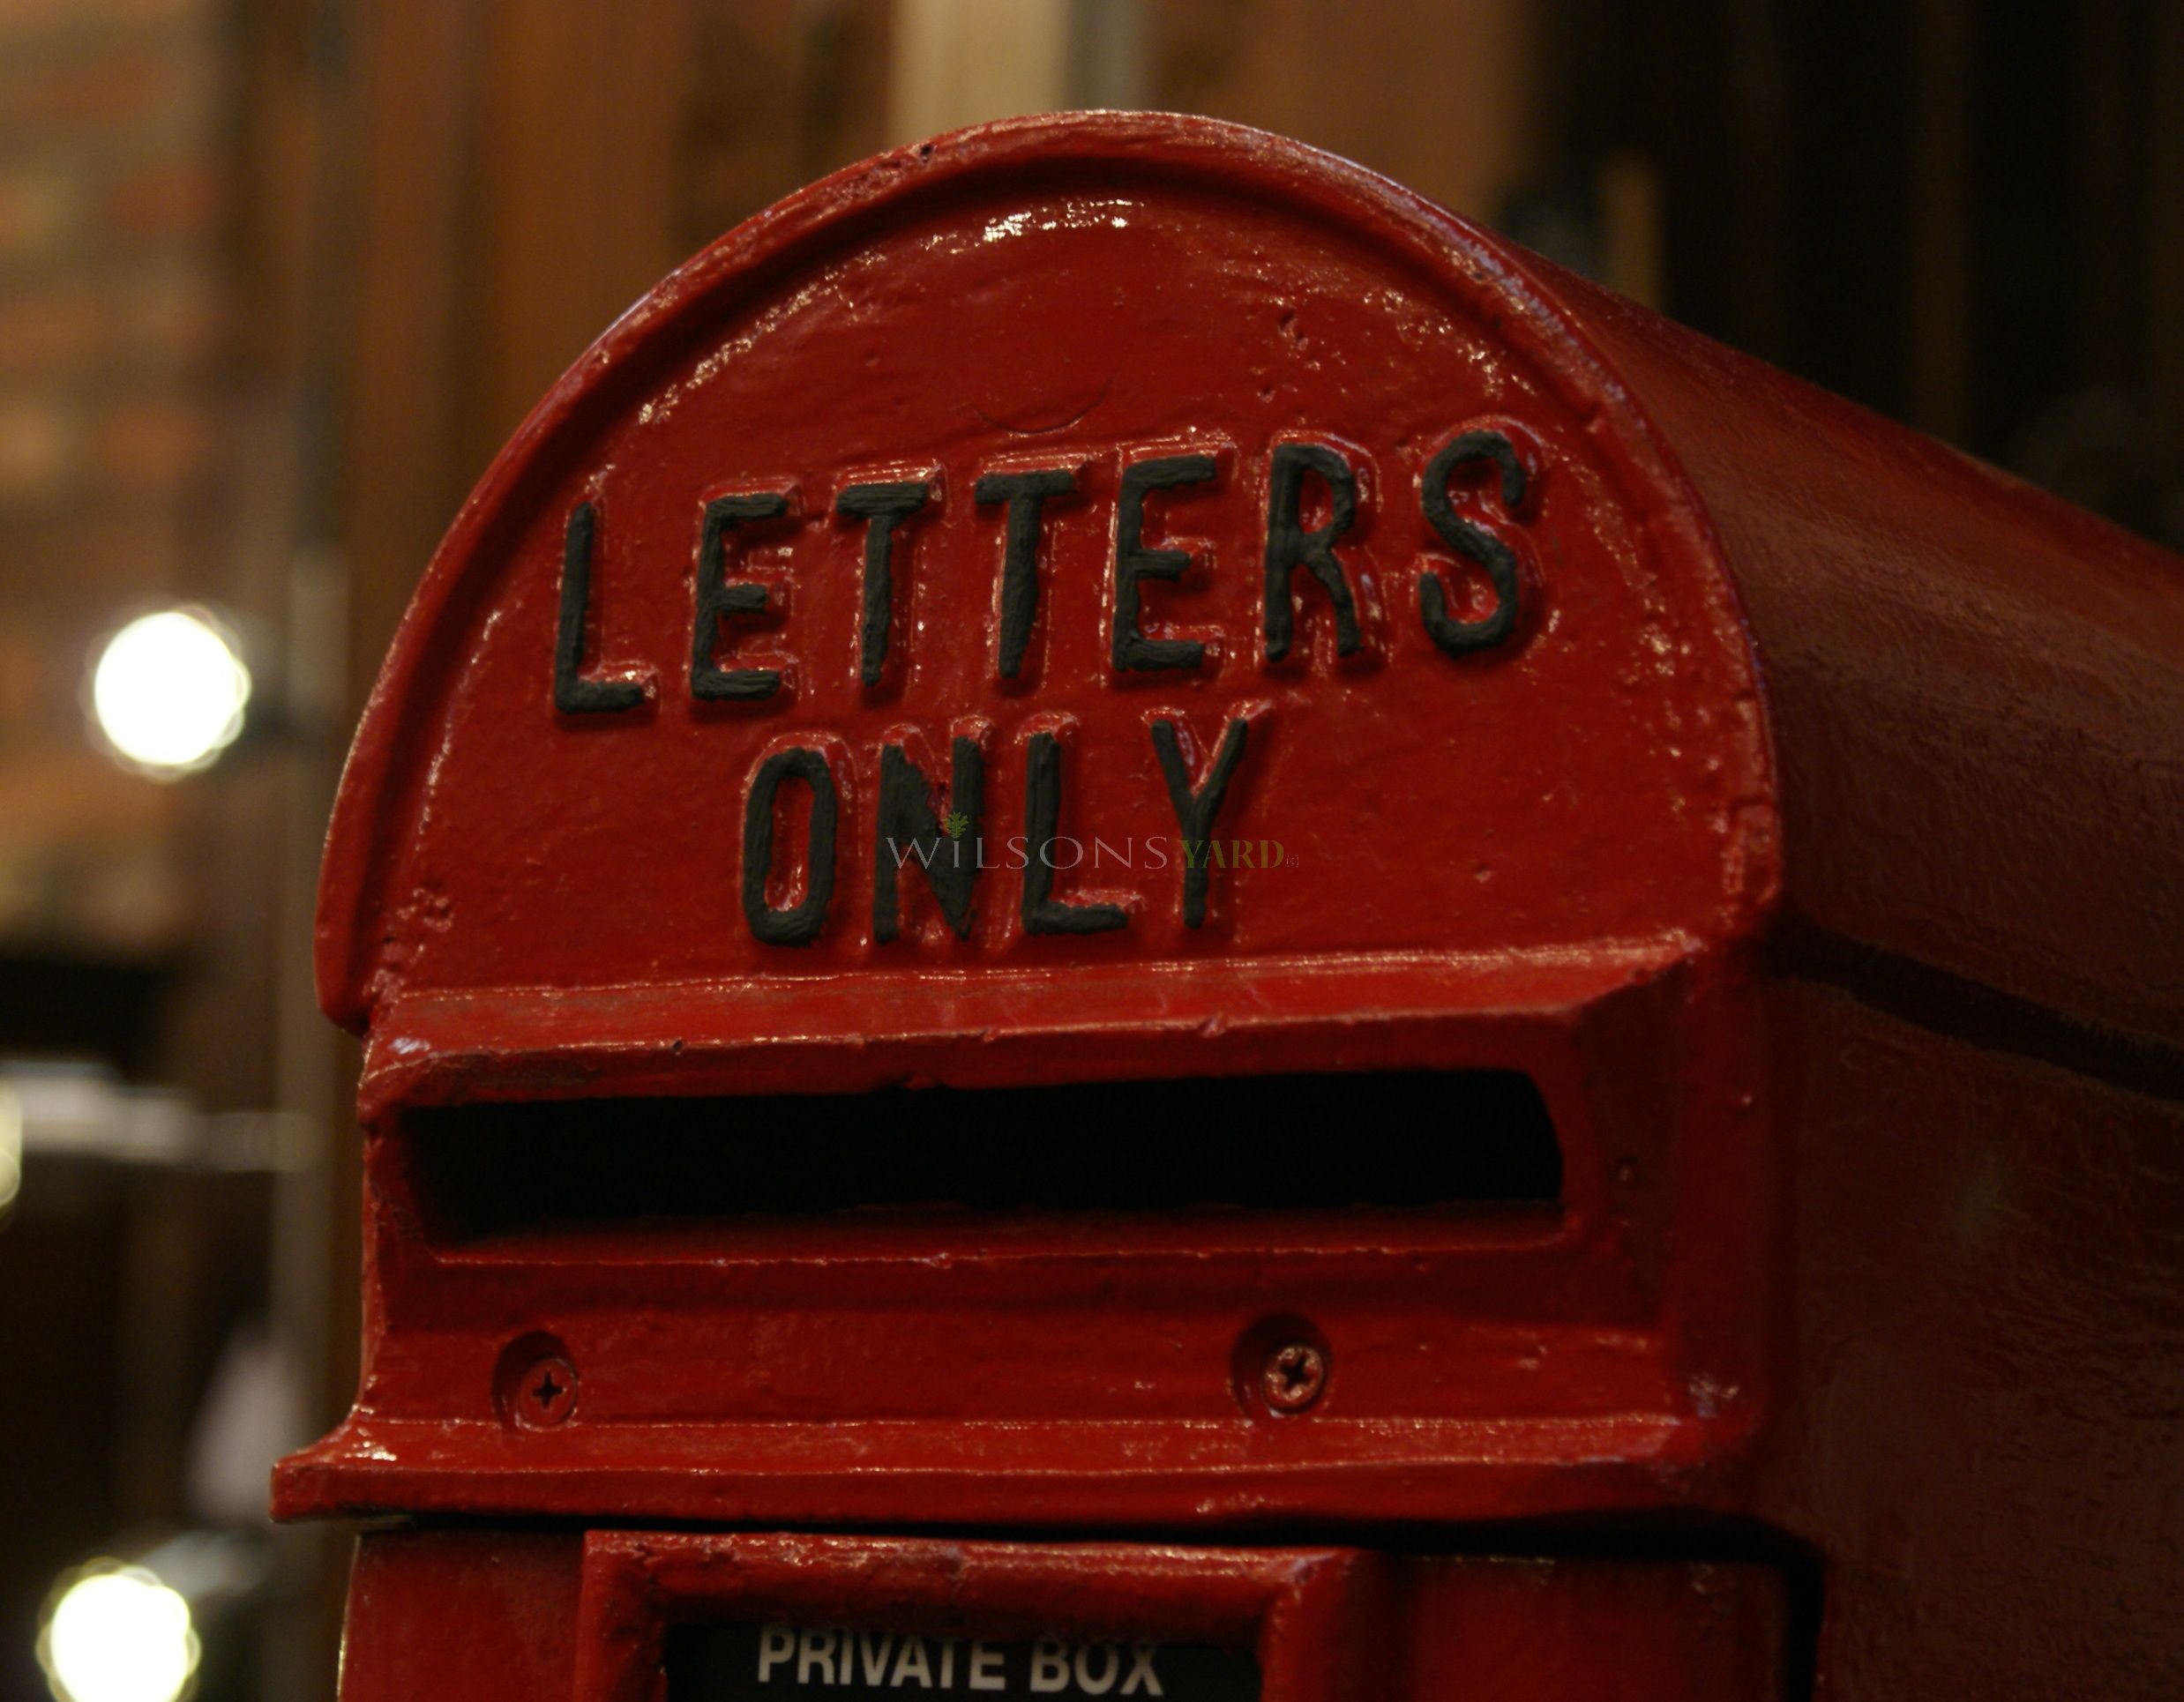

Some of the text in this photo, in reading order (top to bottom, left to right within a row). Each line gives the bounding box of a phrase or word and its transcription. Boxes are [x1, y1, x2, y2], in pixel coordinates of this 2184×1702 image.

[551, 428, 1530, 714] LETTERS
[739, 717, 1249, 948] ONLY
[756, 1625, 1165, 1698] PRIVATE BOX
